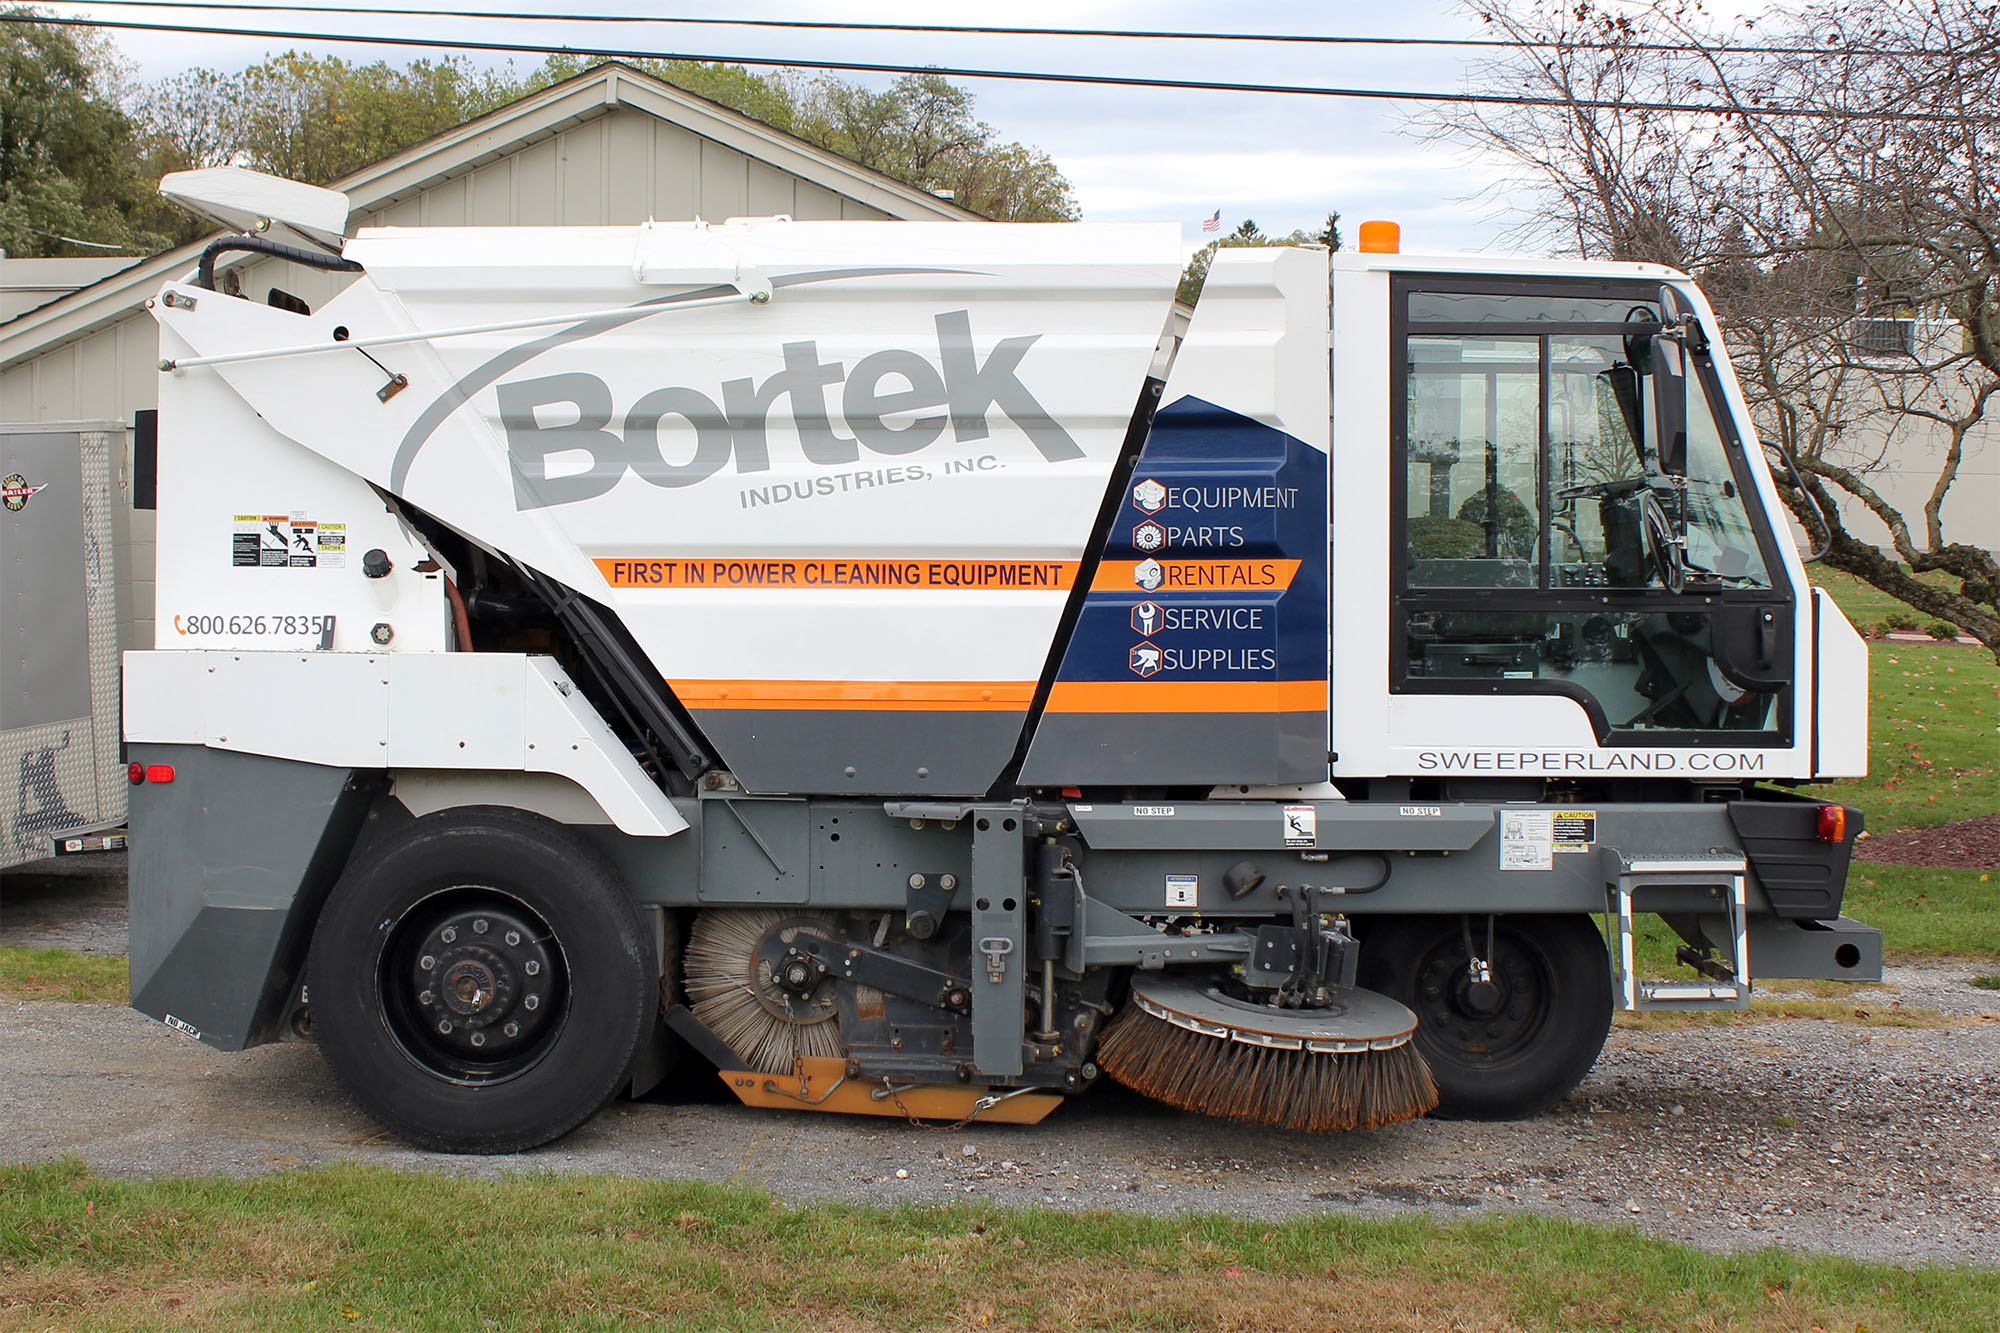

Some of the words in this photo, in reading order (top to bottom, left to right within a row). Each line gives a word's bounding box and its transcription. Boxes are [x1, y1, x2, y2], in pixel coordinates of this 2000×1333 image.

[495, 309, 1086, 511] Bortek
[740, 465, 932, 509] INDUSTRIES,
[944, 455, 1006, 475] INC.
[1168, 487, 1298, 512] EQUIPMENT
[1168, 526, 1244, 547] PARTS
[614, 563, 677, 583] FIRST
[684, 563, 704, 583] IN
[713, 563, 796, 584] POWER
[804, 563, 920, 585] CLEANING
[928, 564, 1063, 586] EQUIPMENT
[1169, 564, 1275, 585] RENTALS
[186, 615, 322, 635] 800.626.7835
[1165, 608, 1263, 630] SERVICE
[1163, 648, 1276, 670] SUPPLIES
[1417, 752, 1764, 771] SWEEPERLAND.COM
[1136, 807, 1148, 815] NO
[1151, 807, 1172, 815] STEP
[1402, 807, 1415, 815] NO
[1417, 807, 1438, 815] STEP
[1563, 811, 1594, 819] CAUTION
[167, 1016, 178, 1027] NO
[179, 1022, 197, 1037] JACK
